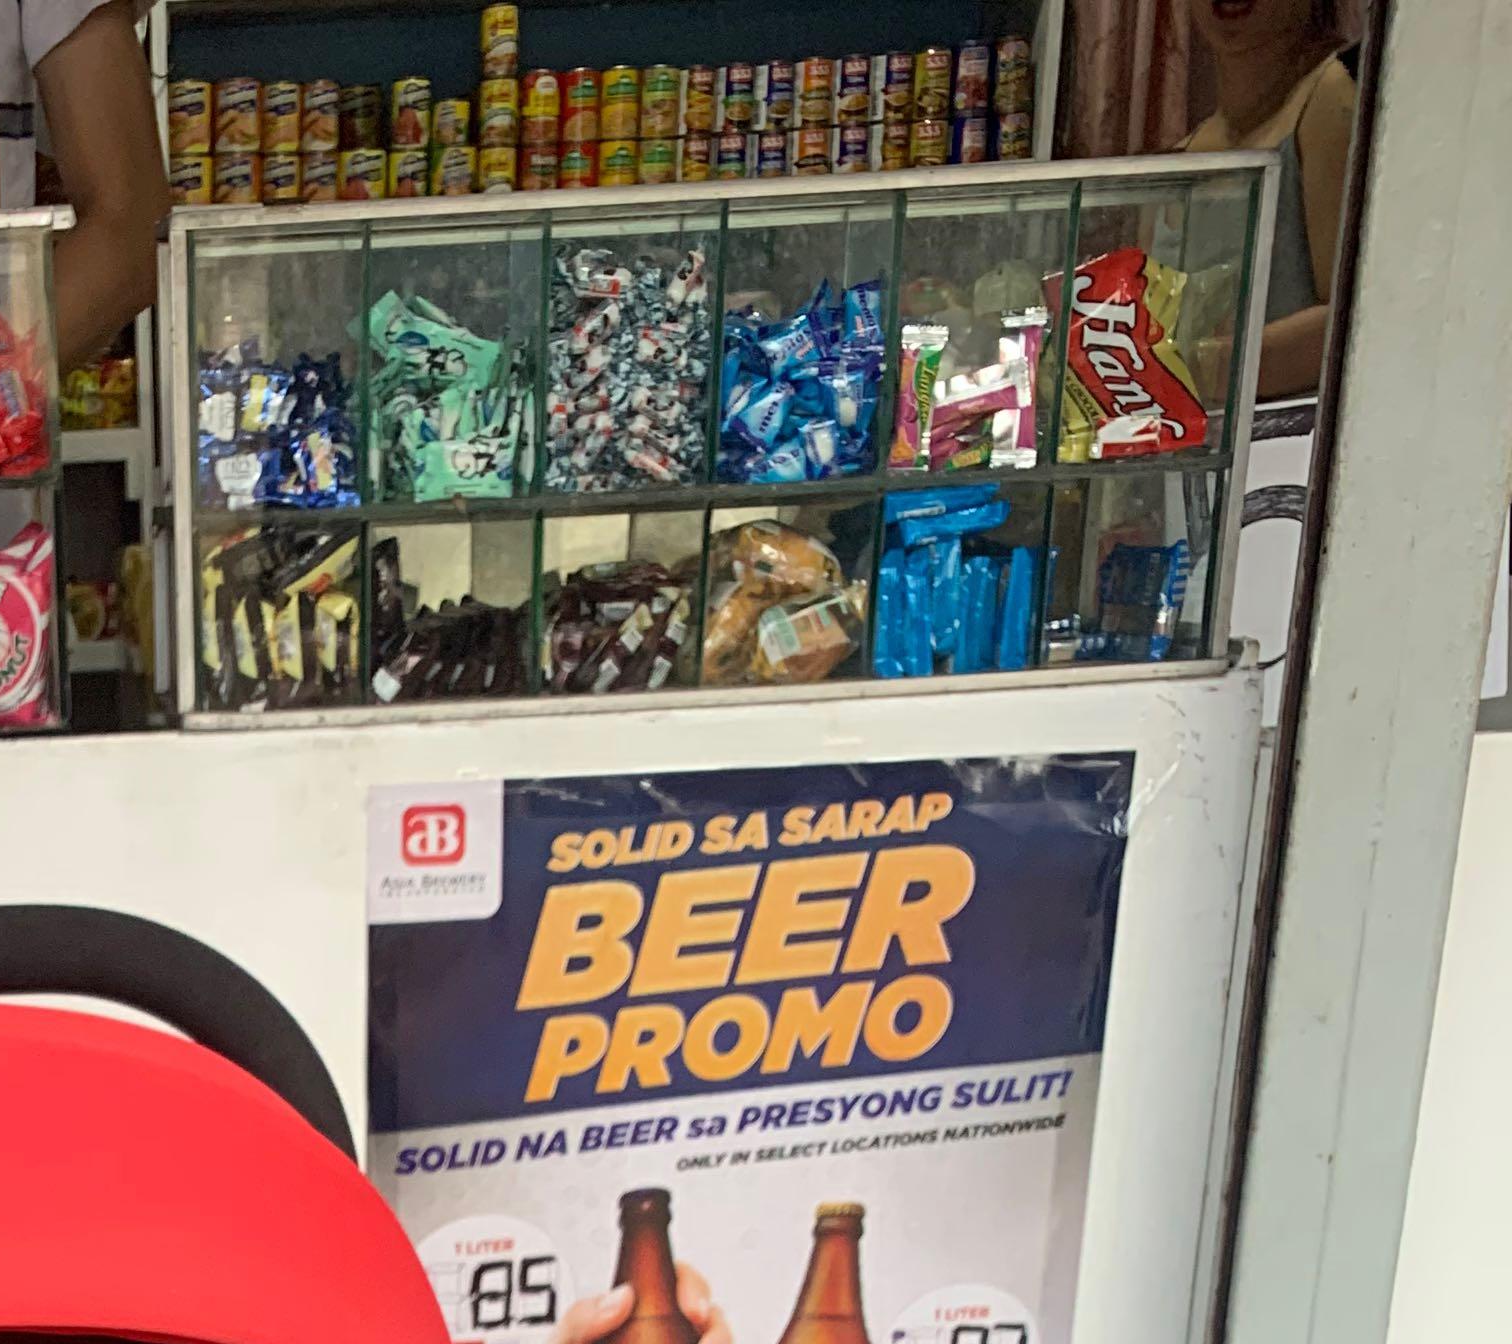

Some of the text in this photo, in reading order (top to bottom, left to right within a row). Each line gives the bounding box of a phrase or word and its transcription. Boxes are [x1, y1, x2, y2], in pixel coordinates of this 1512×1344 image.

[1072, 275, 1185, 439] Hany
[546, 792, 954, 872] SOLID SA SARAP
[515, 843, 977, 1012] BEER
[524, 973, 955, 1104] PROMO
[395, 1070, 1076, 1175] SOLID NA BEER sa PRESYONG SULIT!
[676, 1113, 1068, 1172] ONLY IN SELECT LOCATIONS NATIONWIDE
[466, 1239, 516, 1256] LITER
[469, 1254, 558, 1330] 85
[944, 1305, 992, 1321] LITER
